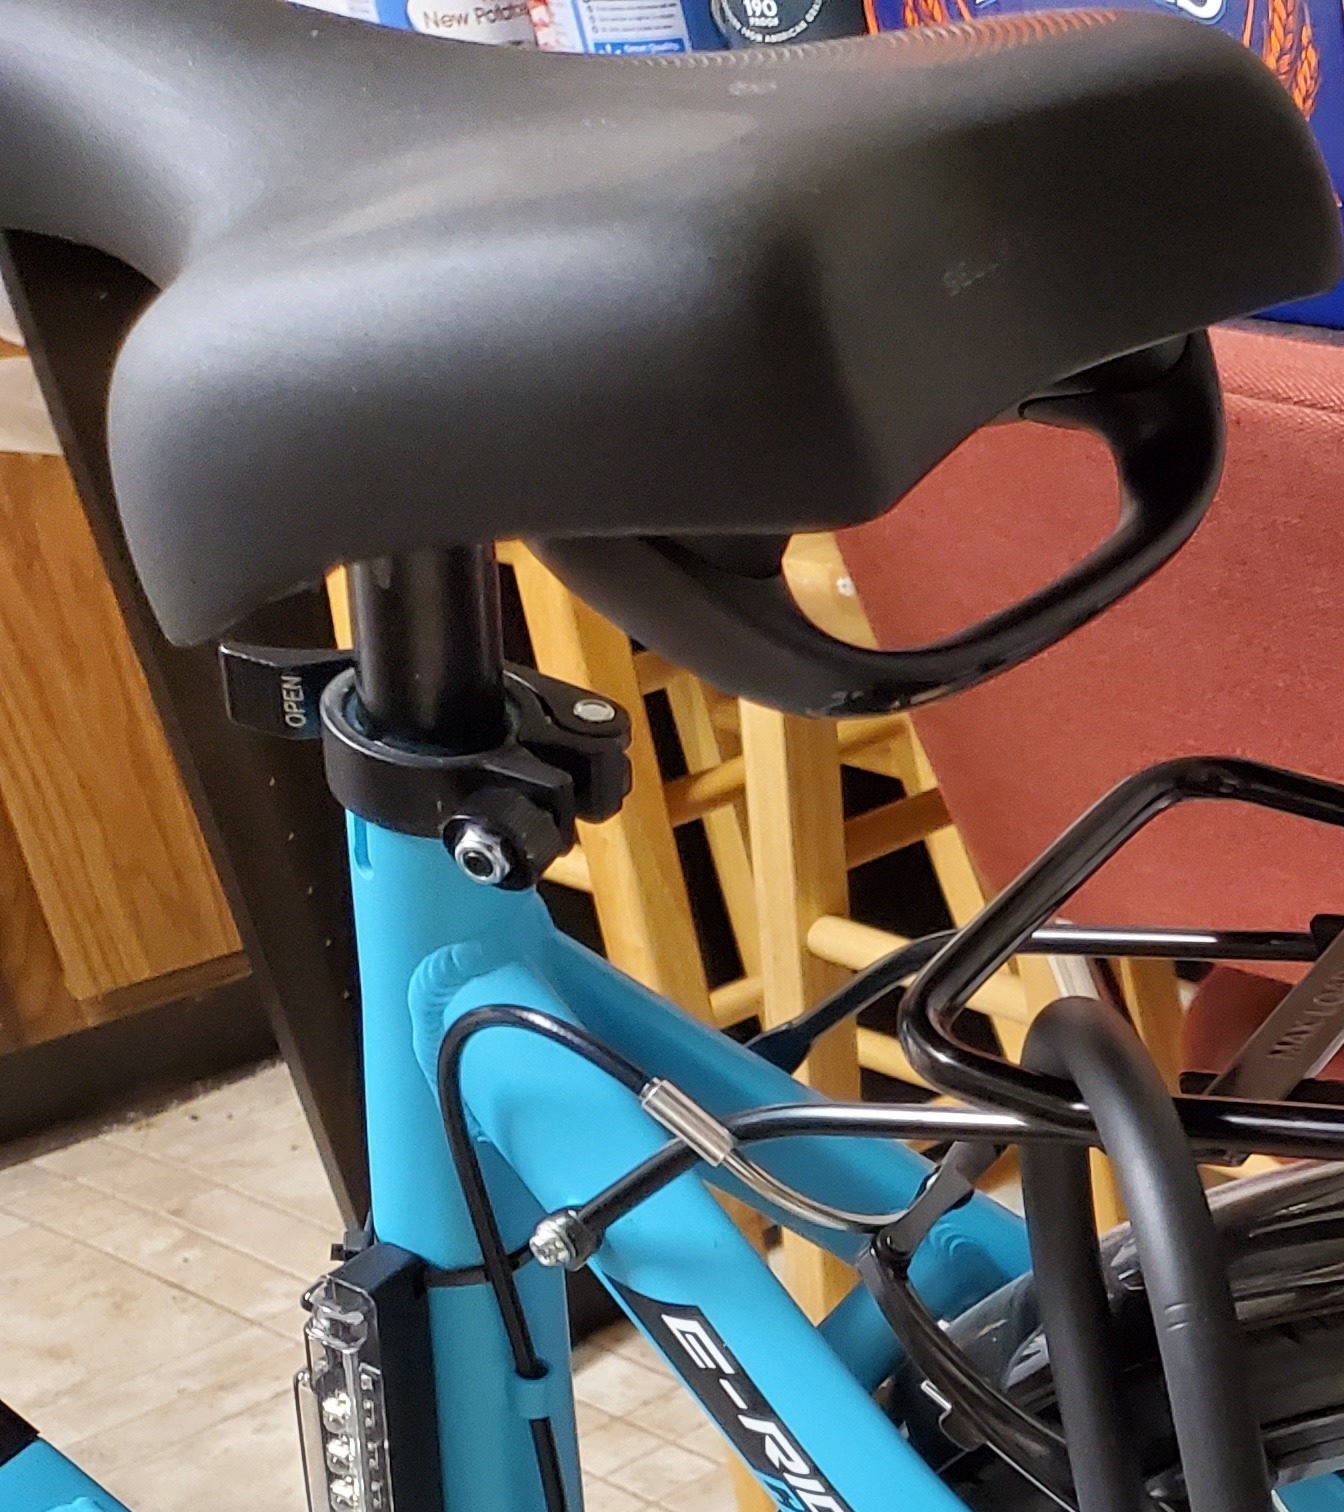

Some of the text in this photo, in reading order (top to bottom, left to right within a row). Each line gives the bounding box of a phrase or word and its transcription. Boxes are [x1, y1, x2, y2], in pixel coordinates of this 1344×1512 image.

[743, 0, 778, 17] 190
[424, 12, 468, 29] New
[281, 675, 306, 728] OPEN
